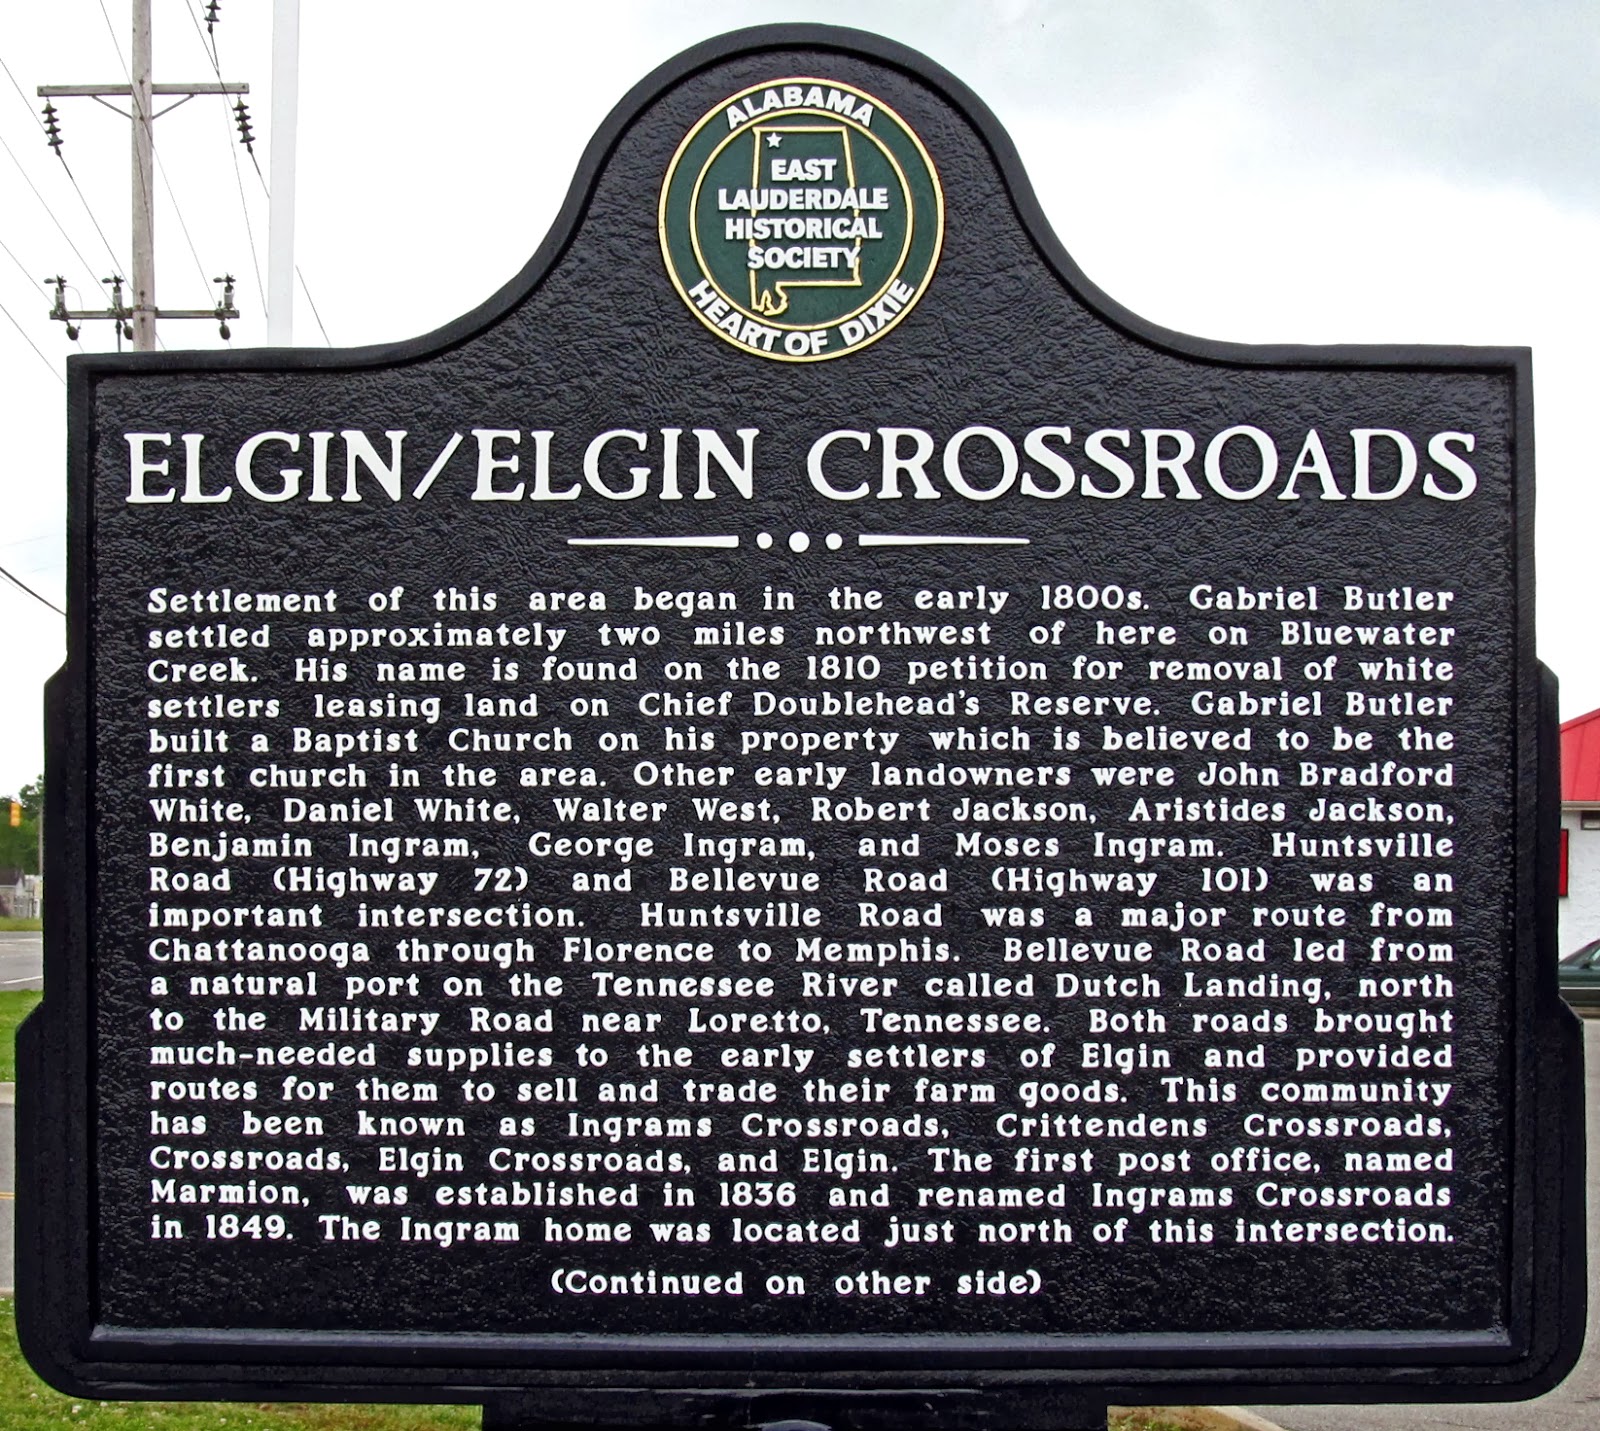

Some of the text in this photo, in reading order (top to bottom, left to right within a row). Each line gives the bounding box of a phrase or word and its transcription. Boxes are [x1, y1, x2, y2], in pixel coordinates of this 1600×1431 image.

[725, 86, 874, 130] ALABAMA
[771, 159, 837, 181] EAST
[718, 188, 889, 211] LAUDERDALE
[724, 217, 882, 239] HISTORICAL
[747, 246, 861, 269] SOCIETY
[687, 279, 914, 355] HEART OF DIXIE
[123, 424, 1478, 504] ELGIN/ELGIN CROSSROADS
[147, 584, 1454, 618] Settlement of this area began in the early 1800s. Gabriel Butler
[148, 620, 1456, 652] settled approximately two miles northwest of here on Bluewater
[147, 689, 1453, 724] settlers leasing land on Chief Doublehead's Reserve. Gabriel Butler
[149, 725, 1454, 758] built a Baptist Church on his property which is believed to be the
[149, 796, 1454, 825] White, Daniel White, Walter West, Robert Jackson, Aristides Jackson,
[148, 830, 1454, 864] Benjamin Ingram, George Ingram, and Moses Ingram. Huntsville
[148, 901, 1453, 932] important intersection. Huntsville Road was a major route from
[148, 936, 1454, 969] Chattanooga through Florence to Memphis. Bellevue Road led from
[149, 1006, 1454, 1039] to the Military Road near Loretto, Tennessee. Both roads brought
[150, 1040, 1453, 1075] much-needed supplies to the early settlers of Elgin and provided
[150, 1110, 1451, 1143] has been known as Ingrams Crossroads, Crittendens Crossroads,
[149, 1145, 1453, 1180] Crossroads, Elgin Crossroads, and Elgin. The first post office, named
[150, 1179, 1451, 1214] Marmion, was established in 1836 and renamed Ingrams Crossroads
[151, 1214, 1454, 1248] in 1849. The Ingram home was located just north of this intersection.
[551, 1268, 1042, 1295] (Continued on other side)
